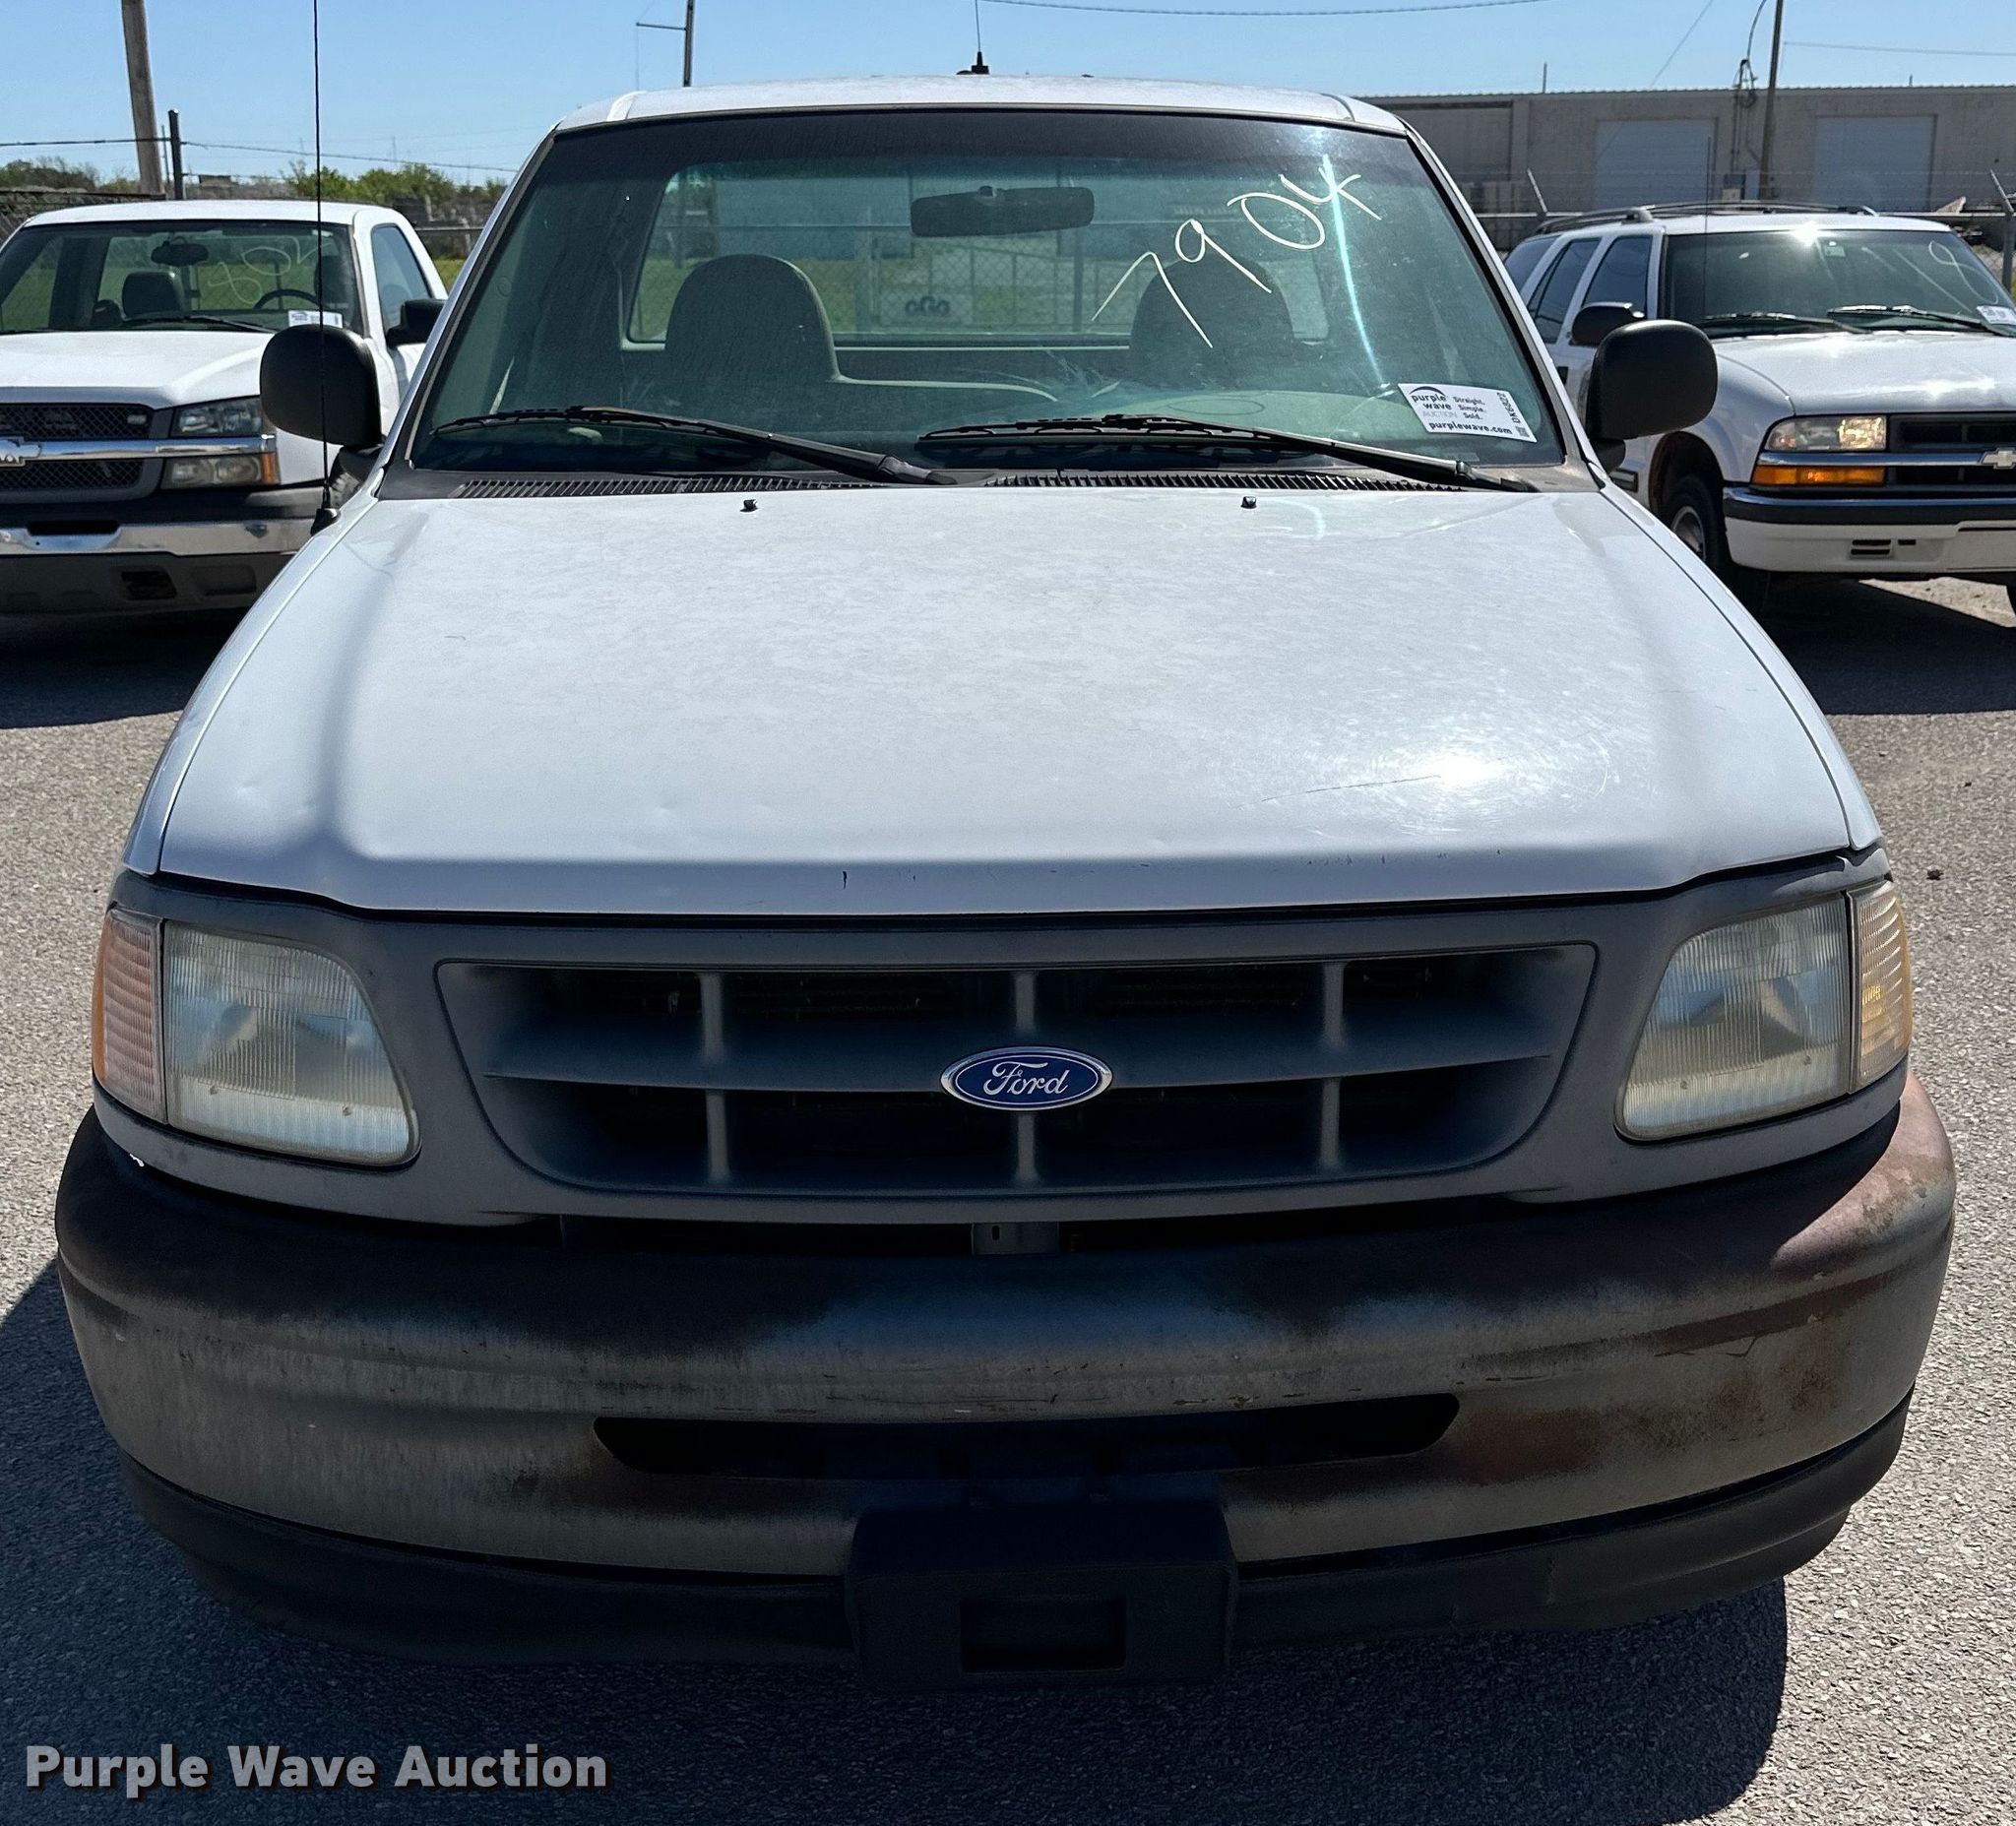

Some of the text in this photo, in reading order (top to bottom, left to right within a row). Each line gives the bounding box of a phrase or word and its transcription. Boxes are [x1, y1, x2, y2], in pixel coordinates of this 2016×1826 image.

[1091, 162, 1382, 348] 7904
[1411, 394, 1447, 403] purple
[1429, 421, 1513, 434] purplewave.com
[983, 1061, 1070, 1096] Ford
